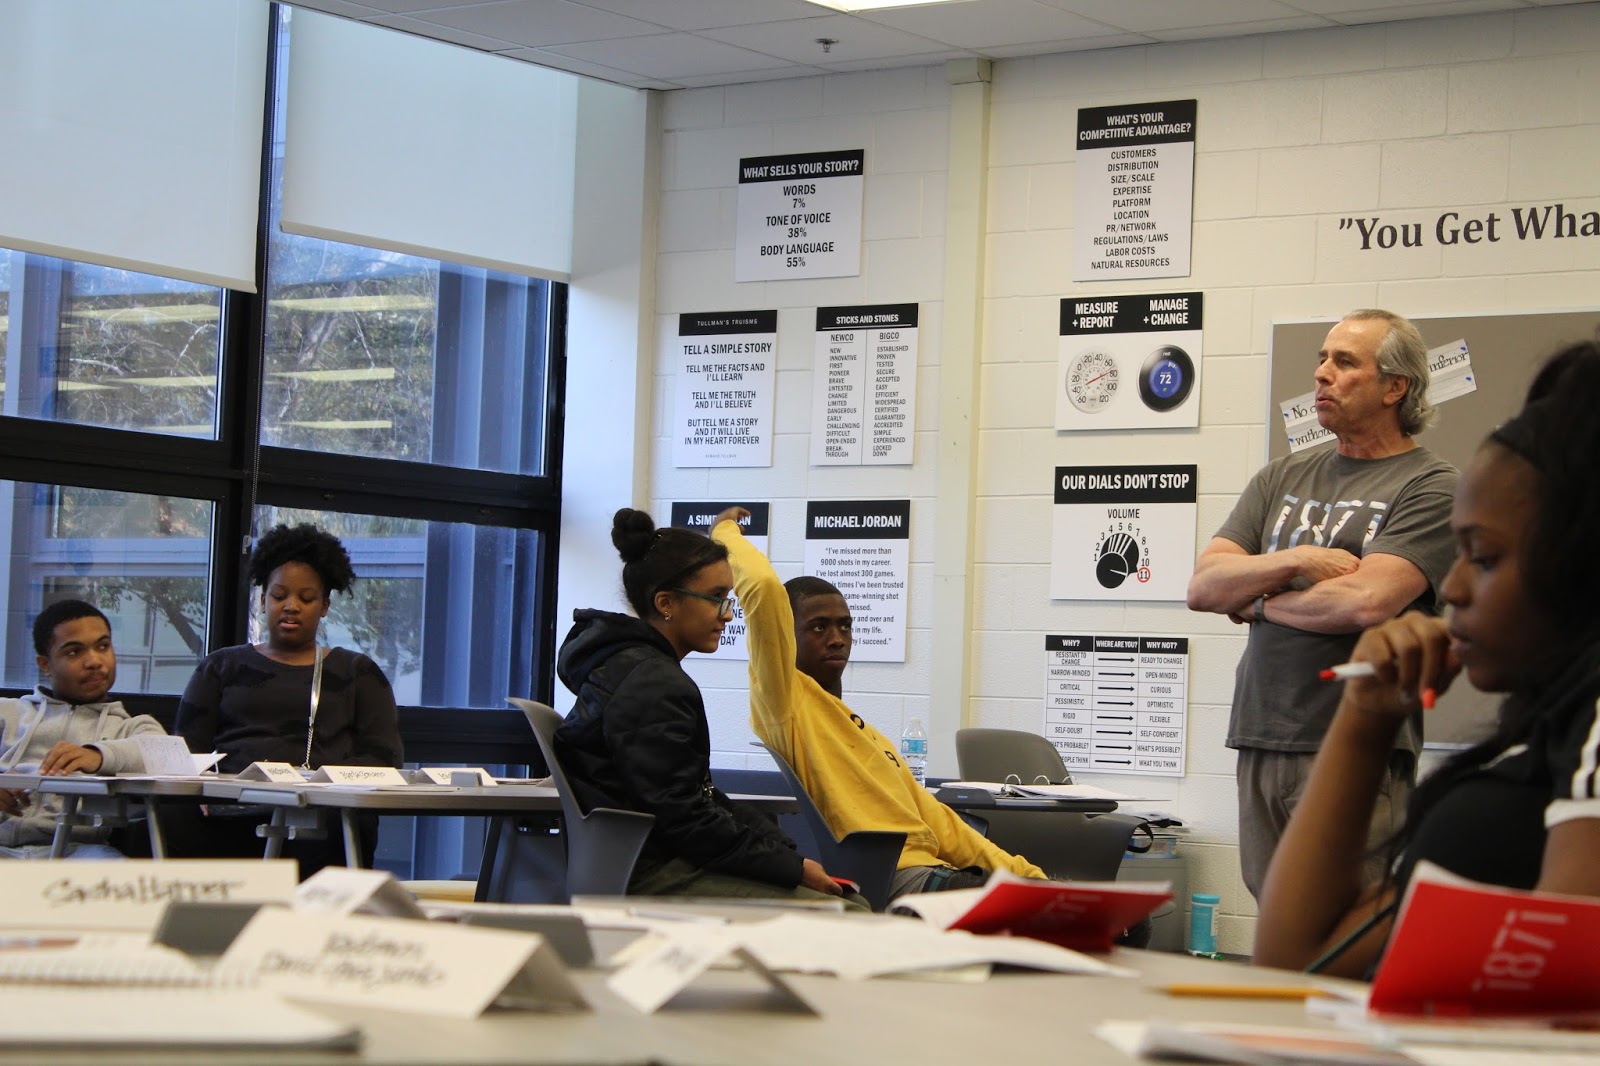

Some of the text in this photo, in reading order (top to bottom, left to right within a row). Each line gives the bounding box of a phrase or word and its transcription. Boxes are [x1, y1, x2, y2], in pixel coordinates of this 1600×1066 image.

[1107, 112, 1164, 126] WHAT'S YOUR
[1080, 123, 1191, 140] COMPETITIVE ADVANTAGE?
[1111, 149, 1156, 159] CUSTOMERS
[744, 160, 859, 178] WHAT SELLS YOUR STORY?
[1108, 161, 1158, 172] DISTRIBUTION
[1111, 173, 1155, 184] SIZE/SCALE
[783, 184, 816, 196] WORDS
[1113, 186, 1152, 196] EXPERTISE
[793, 198, 806, 208] 7%
[1113, 198, 1151, 207] PLATFORM
[766, 212, 831, 226] TONE OF VOICE
[1114, 210, 1149, 220] LOCATION
[788, 227, 807, 238] 38%
[1106, 222, 1156, 233] PR/NETWORK
[1435, 212, 1501, 245] Get
[1093, 233, 1169, 245] REGULATIONS/LAWS
[761, 242, 834, 256] BODY LANGUAGE
[1106, 246, 1155, 257] LABOR COSTS
[786, 257, 806, 267] 55%
[1091, 258, 1170, 270] NATURAL RESOURCES
[1075, 302, 1118, 315] MEASURE
[1150, 298, 1188, 311] MANAGE
[836, 314, 899, 324] STICKS AND STONES
[1080, 316, 1114, 328] REPORT
[1151, 312, 1188, 325] CHANGE
[684, 343, 772, 355] TELL A SIMPLE STORY
[686, 365, 701, 373] TELL
[714, 364, 726, 372] THE
[728, 363, 749, 372] FACTS
[750, 363, 765, 371] AND
[721, 373, 743, 381] LEARN
[1160, 375, 1171, 384] 72
[692, 392, 707, 400] TELL
[720, 391, 733, 399] THE
[734, 391, 756, 399] TRUTH
[695, 401, 709, 409] AND
[725, 400, 752, 408] BELIEVE
[1291, 405, 1308, 419] No
[687, 418, 759, 427] BUT TELL ME A STORY
[695, 428, 709, 436] AND
[736, 427, 750, 435] LIVE
[693, 437, 704, 445] MY
[705, 437, 727, 445] HEART
[728, 436, 760, 445] FOREVER
[1295, 429, 1335, 445] withou
[1062, 474, 1189, 490] OUR DIALS DON'T STOP
[1108, 509, 1140, 518] VOLUME
[687, 515, 694, 525] A
[814, 515, 901, 528] MICHAEL JORDAN
[1142, 558, 1150, 567] 10
[1140, 571, 1147, 579] 11
[844, 593, 885, 601] game-winning
[729, 625, 746, 635] WAY
[1062, 639, 1080, 647] WHY?
[1096, 640, 1112, 648] WHERE
[1123, 641, 1138, 649] YOU?
